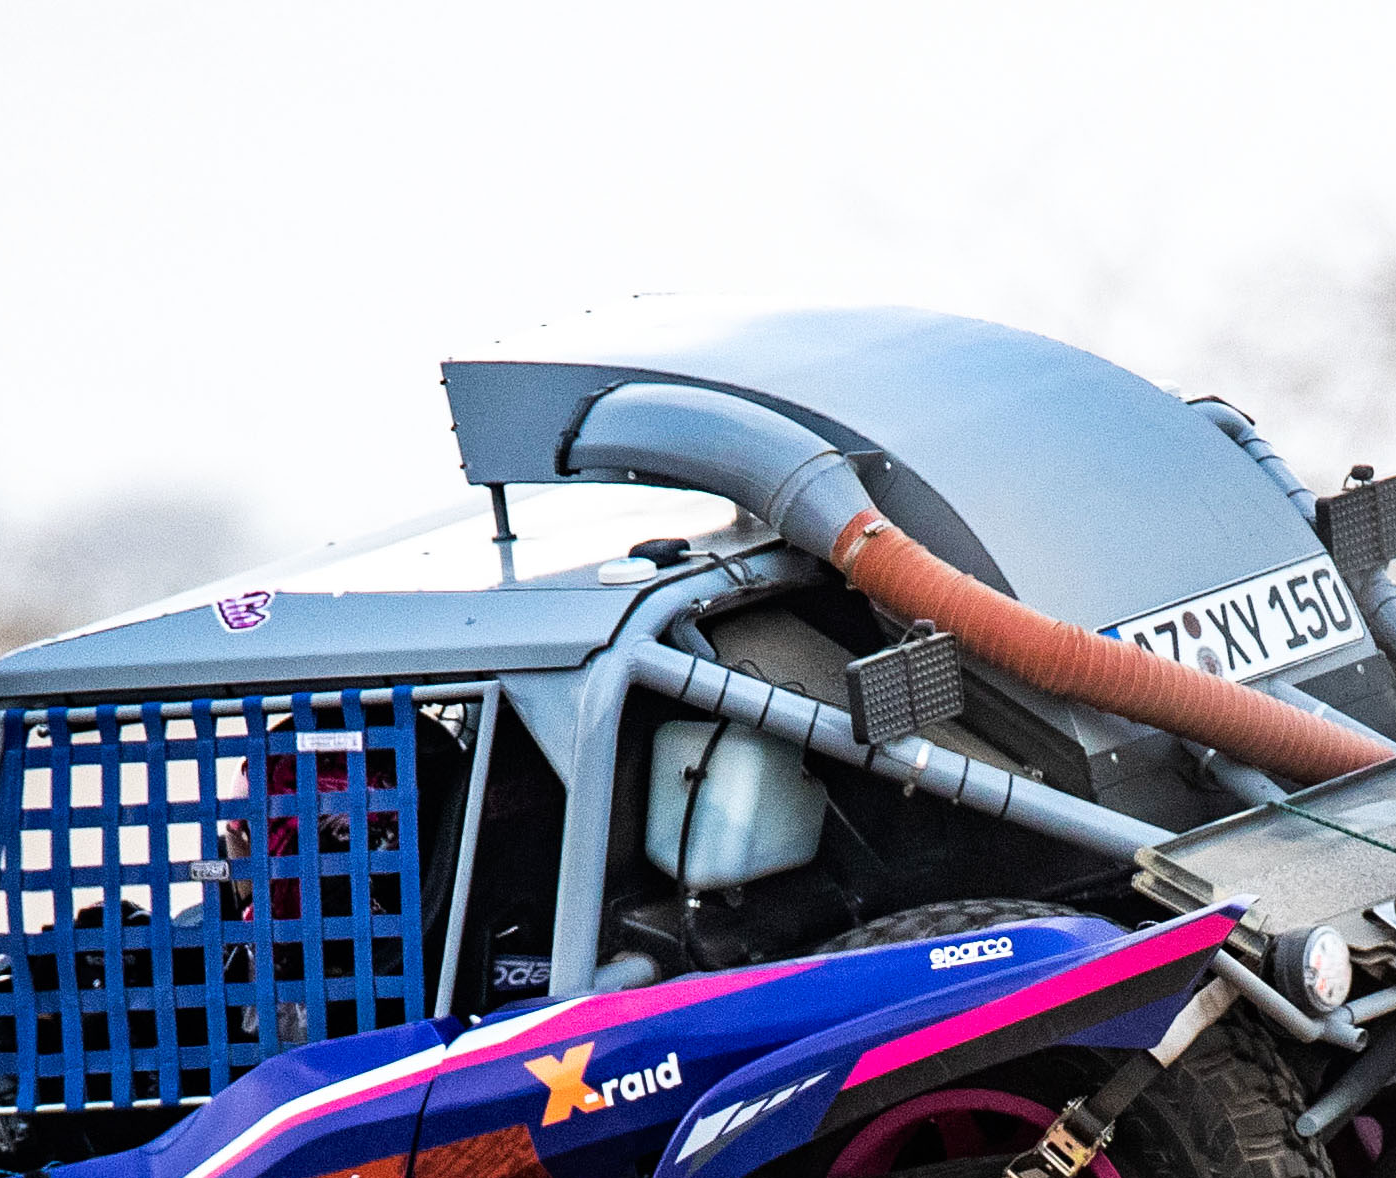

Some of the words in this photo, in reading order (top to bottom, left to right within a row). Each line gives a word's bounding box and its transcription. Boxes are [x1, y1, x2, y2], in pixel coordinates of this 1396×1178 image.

[1205, 593, 1270, 670] XY
[1268, 567, 1353, 650] 150
[929, 936, 1013, 970] sparco
[524, 1041, 682, 1128] X-raid
